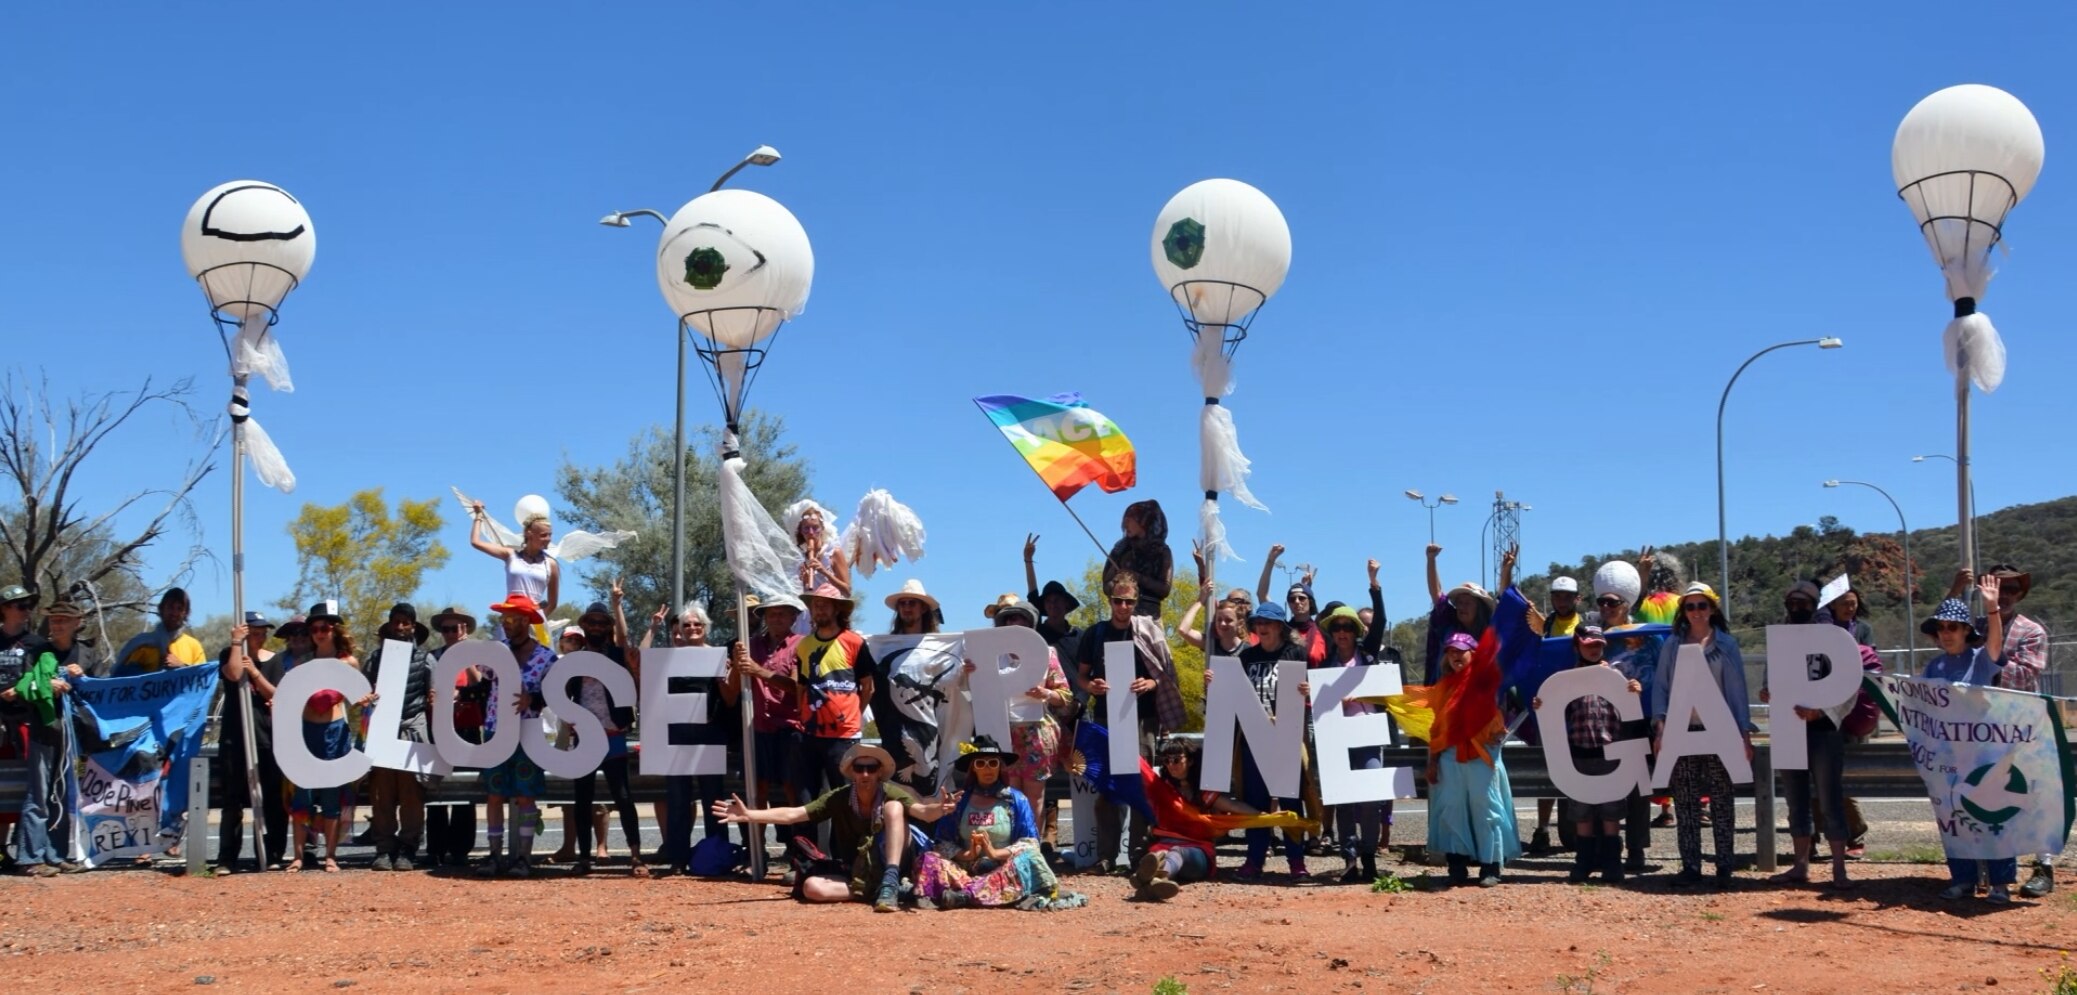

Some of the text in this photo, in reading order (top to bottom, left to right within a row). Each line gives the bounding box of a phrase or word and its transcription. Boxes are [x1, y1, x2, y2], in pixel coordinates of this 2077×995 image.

[108, 686, 138, 705] FOR
[139, 673, 210, 701] SURVIVAL
[272, 624, 1863, 806] CLOSE PINE GAP
